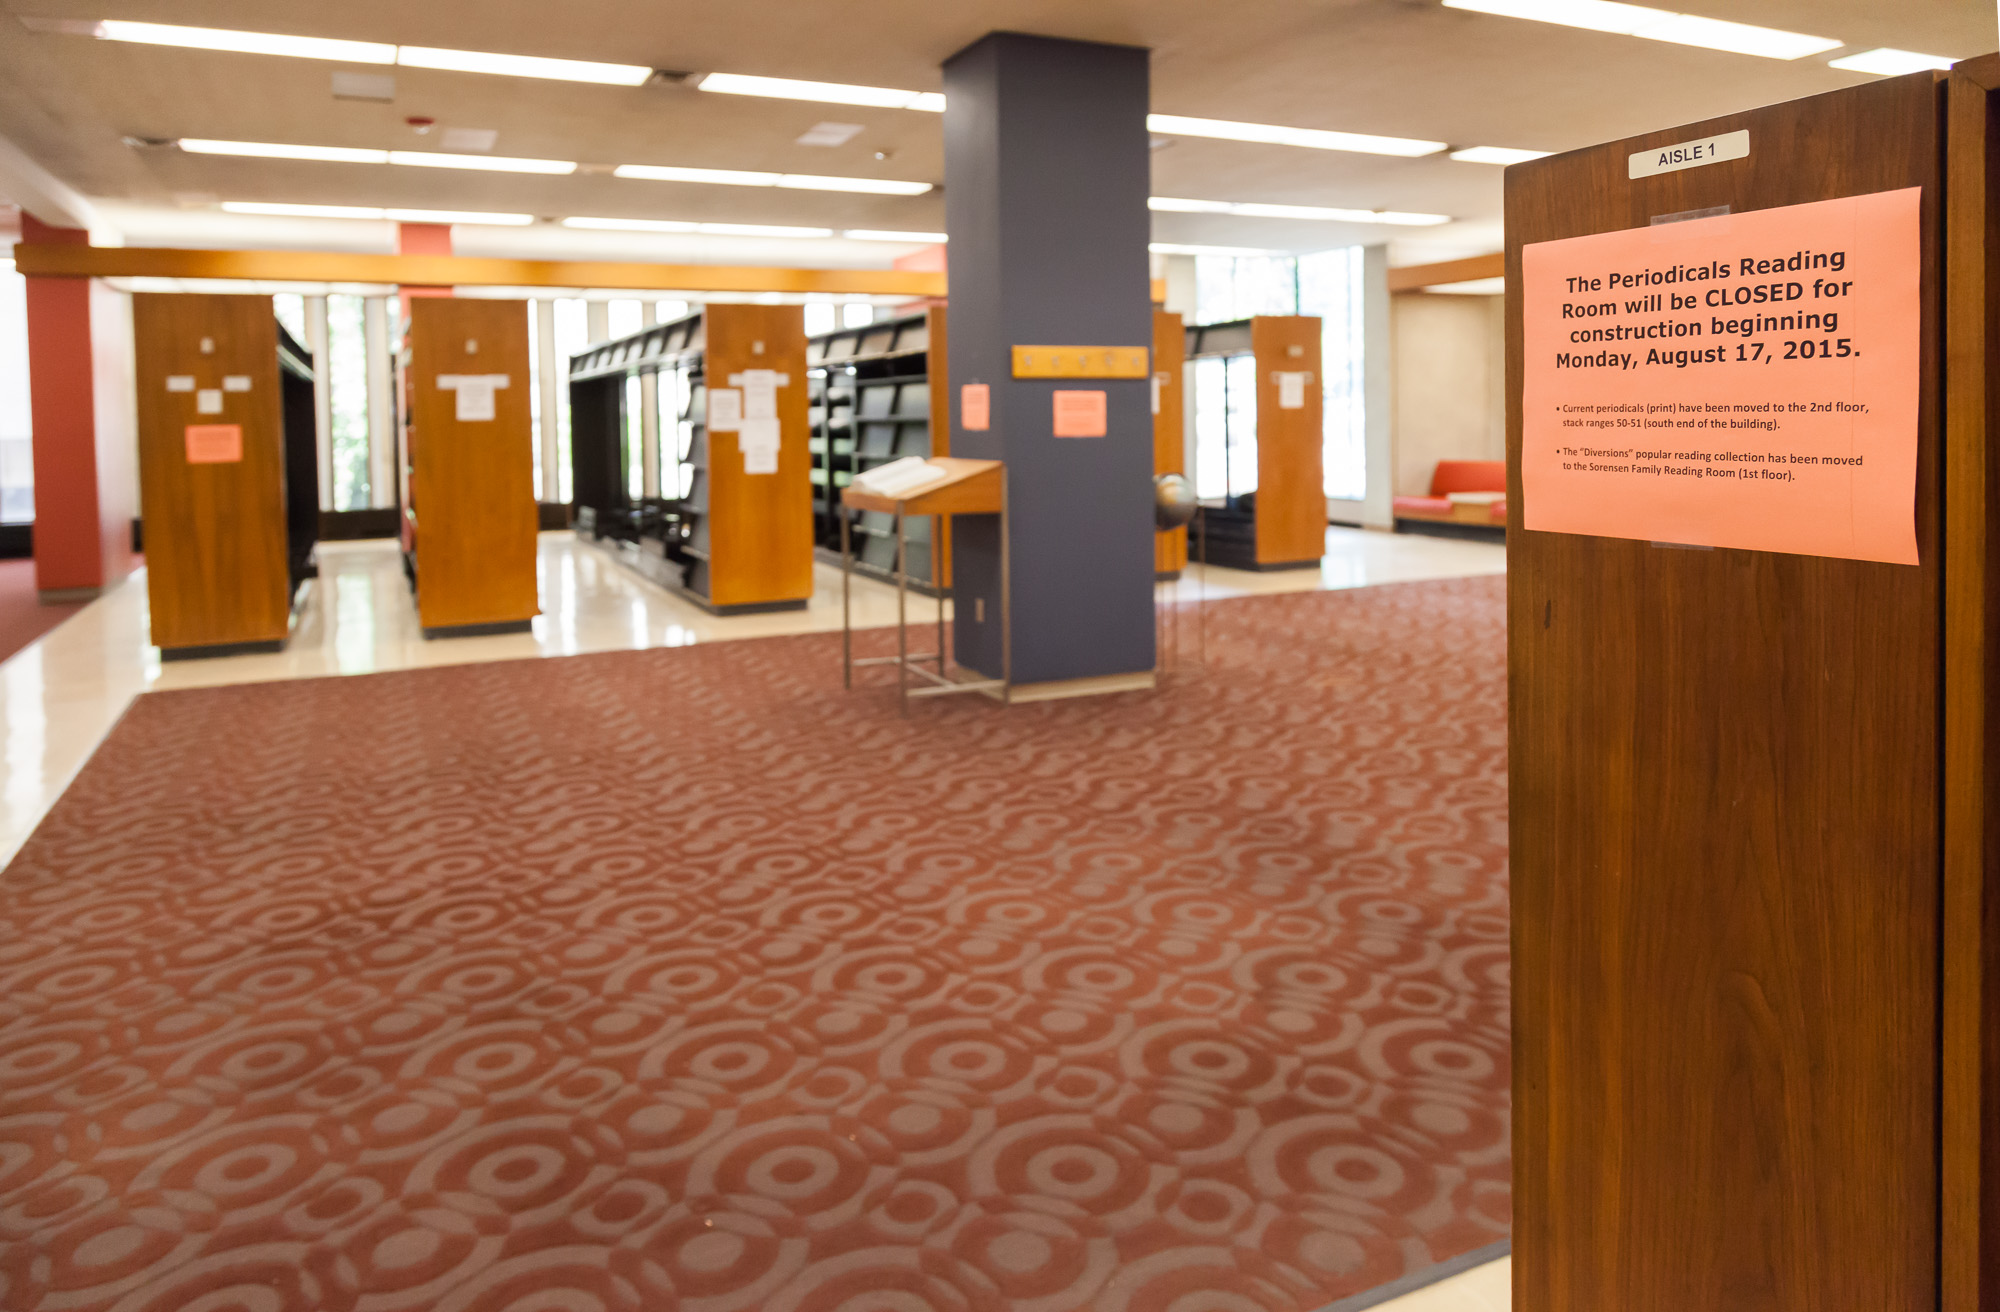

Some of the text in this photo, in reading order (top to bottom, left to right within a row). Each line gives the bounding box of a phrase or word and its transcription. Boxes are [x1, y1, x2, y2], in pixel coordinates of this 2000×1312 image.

[1658, 143, 1714, 166] AISLE 1
[1566, 250, 1845, 293] The Periodicals Reading
[1563, 279, 1853, 319] Room will be CLOSED for
[1570, 310, 1837, 343] construction beginning
[1557, 338, 1860, 370] Monday, August 17, 2015.
[1563, 402, 1869, 414] Current periodicals (print) have been moved to the 2nd floor,
[1563, 418, 1780, 431] stack ranges 50-51 (south end of the building).
[1563, 447, 1577, 456] The
[1636, 450, 1672, 460] popular
[1675, 451, 1711, 463] reading
[1714, 452, 1764, 462] collection
[1768, 453, 1786, 463] has
[1790, 453, 1818, 464] been
[1822, 454, 1863, 466] moved
[1563, 462, 1795, 482] to the Sorensen Family Reading Room (1st floor).
